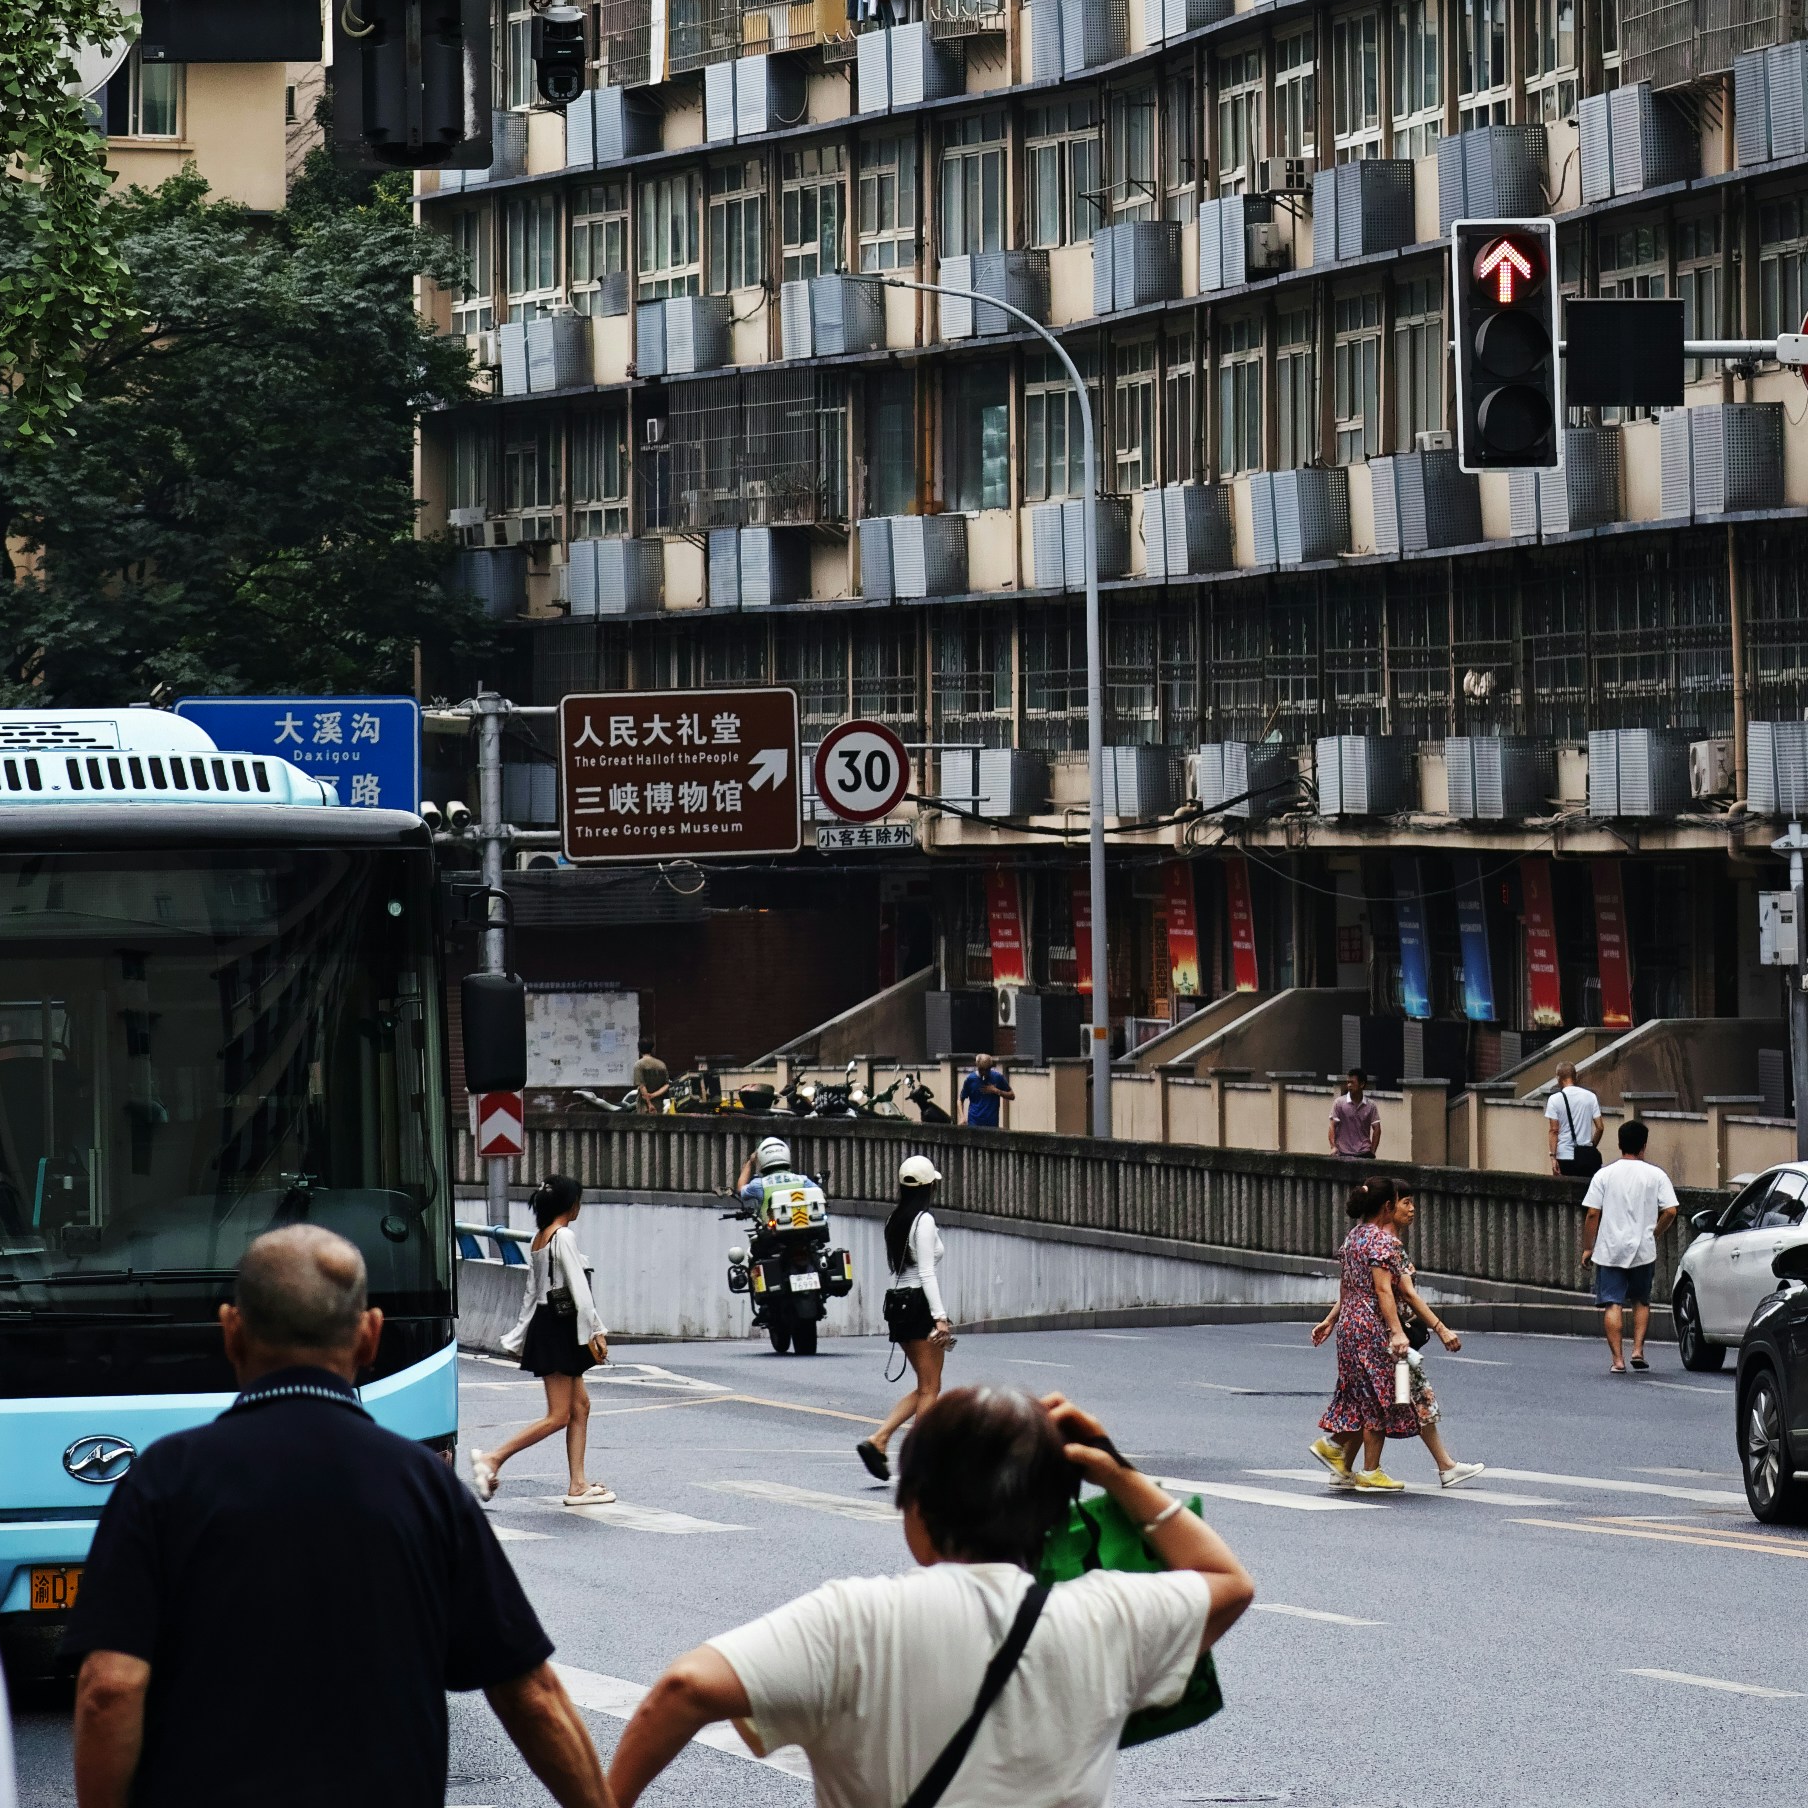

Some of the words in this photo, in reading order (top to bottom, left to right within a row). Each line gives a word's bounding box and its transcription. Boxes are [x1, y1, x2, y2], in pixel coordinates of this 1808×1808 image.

[273, 711, 380, 744] 大溪沟
[573, 712, 741, 748] 人民大礼堂
[293, 749, 361, 763] Daxigou
[575, 756, 596, 767] The
[599, 754, 633, 767] Great
[636, 753, 661, 765] Hall
[678, 753, 697, 764] the
[699, 751, 739, 765] People
[838, 750, 891, 792] 30
[574, 780, 743, 815] 三峡博物馆
[576, 826, 618, 838] Three
[623, 824, 676, 838] Gorges
[680, 822, 743, 835] Museum
[820, 826, 911, 847] 小客车除外
[35, 1574, 81, 1604] 渝D·
